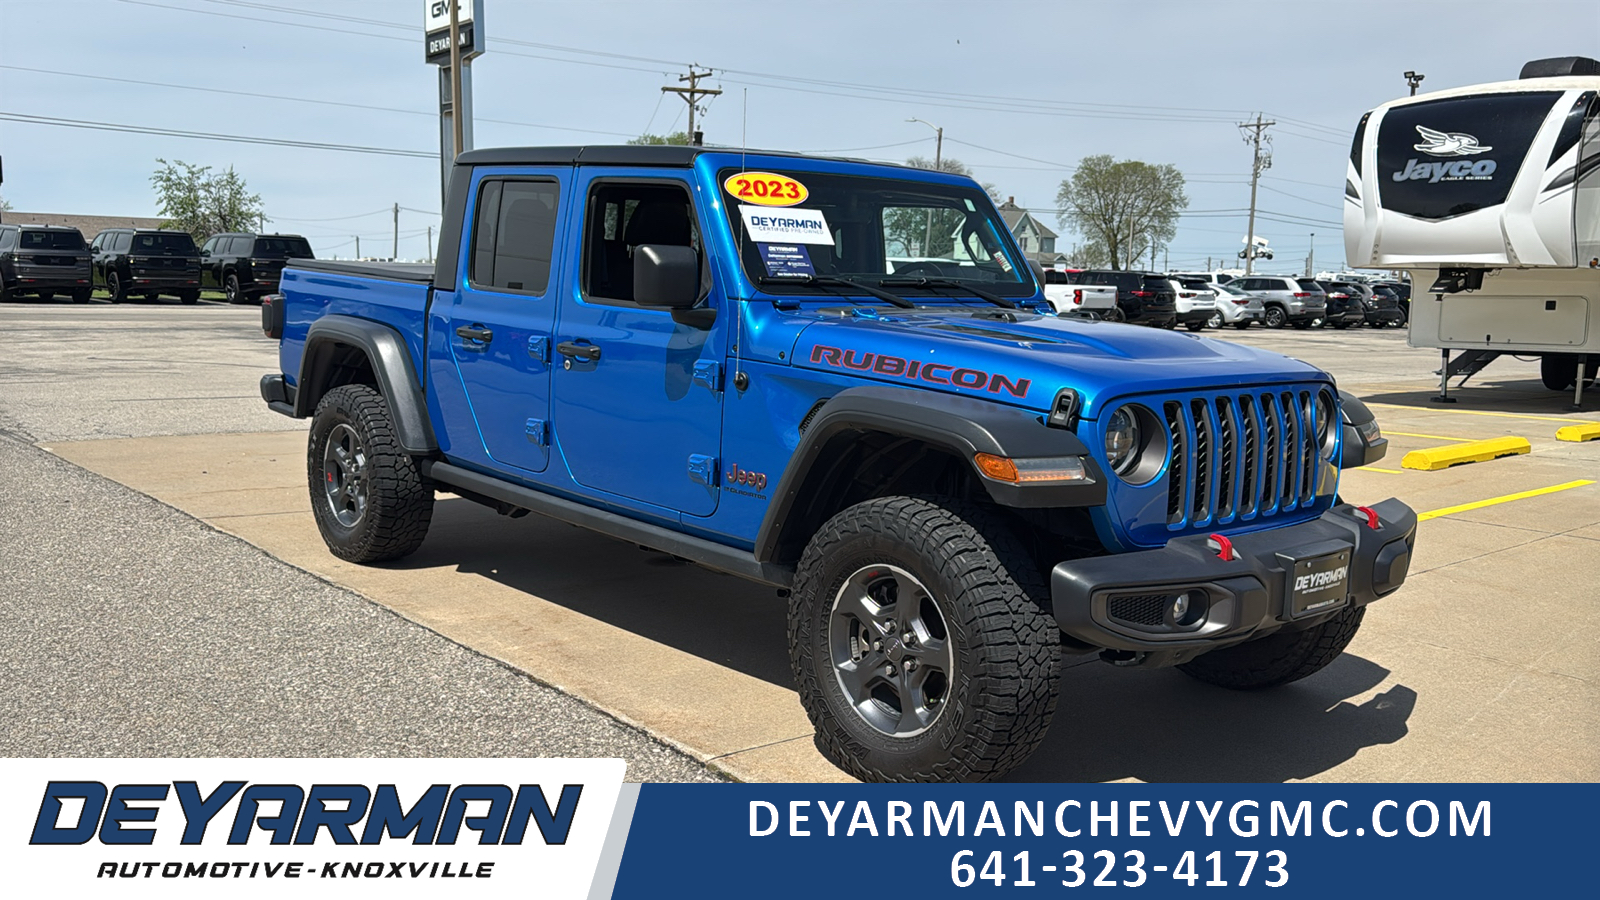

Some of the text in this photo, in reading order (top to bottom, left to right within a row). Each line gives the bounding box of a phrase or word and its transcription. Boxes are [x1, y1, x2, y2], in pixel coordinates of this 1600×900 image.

[431, 0, 462, 18] GM
[1392, 158, 1497, 183] Jayco
[736, 179, 801, 199] 2023
[752, 216, 822, 230] DEYARMAN
[791, 227, 824, 235] PRE-OWNED
[809, 344, 1032, 399] RUBICON
[726, 463, 767, 492] Jeep
[730, 487, 767, 500] GLADIATOR
[1294, 565, 1348, 591] DEYARMAN
